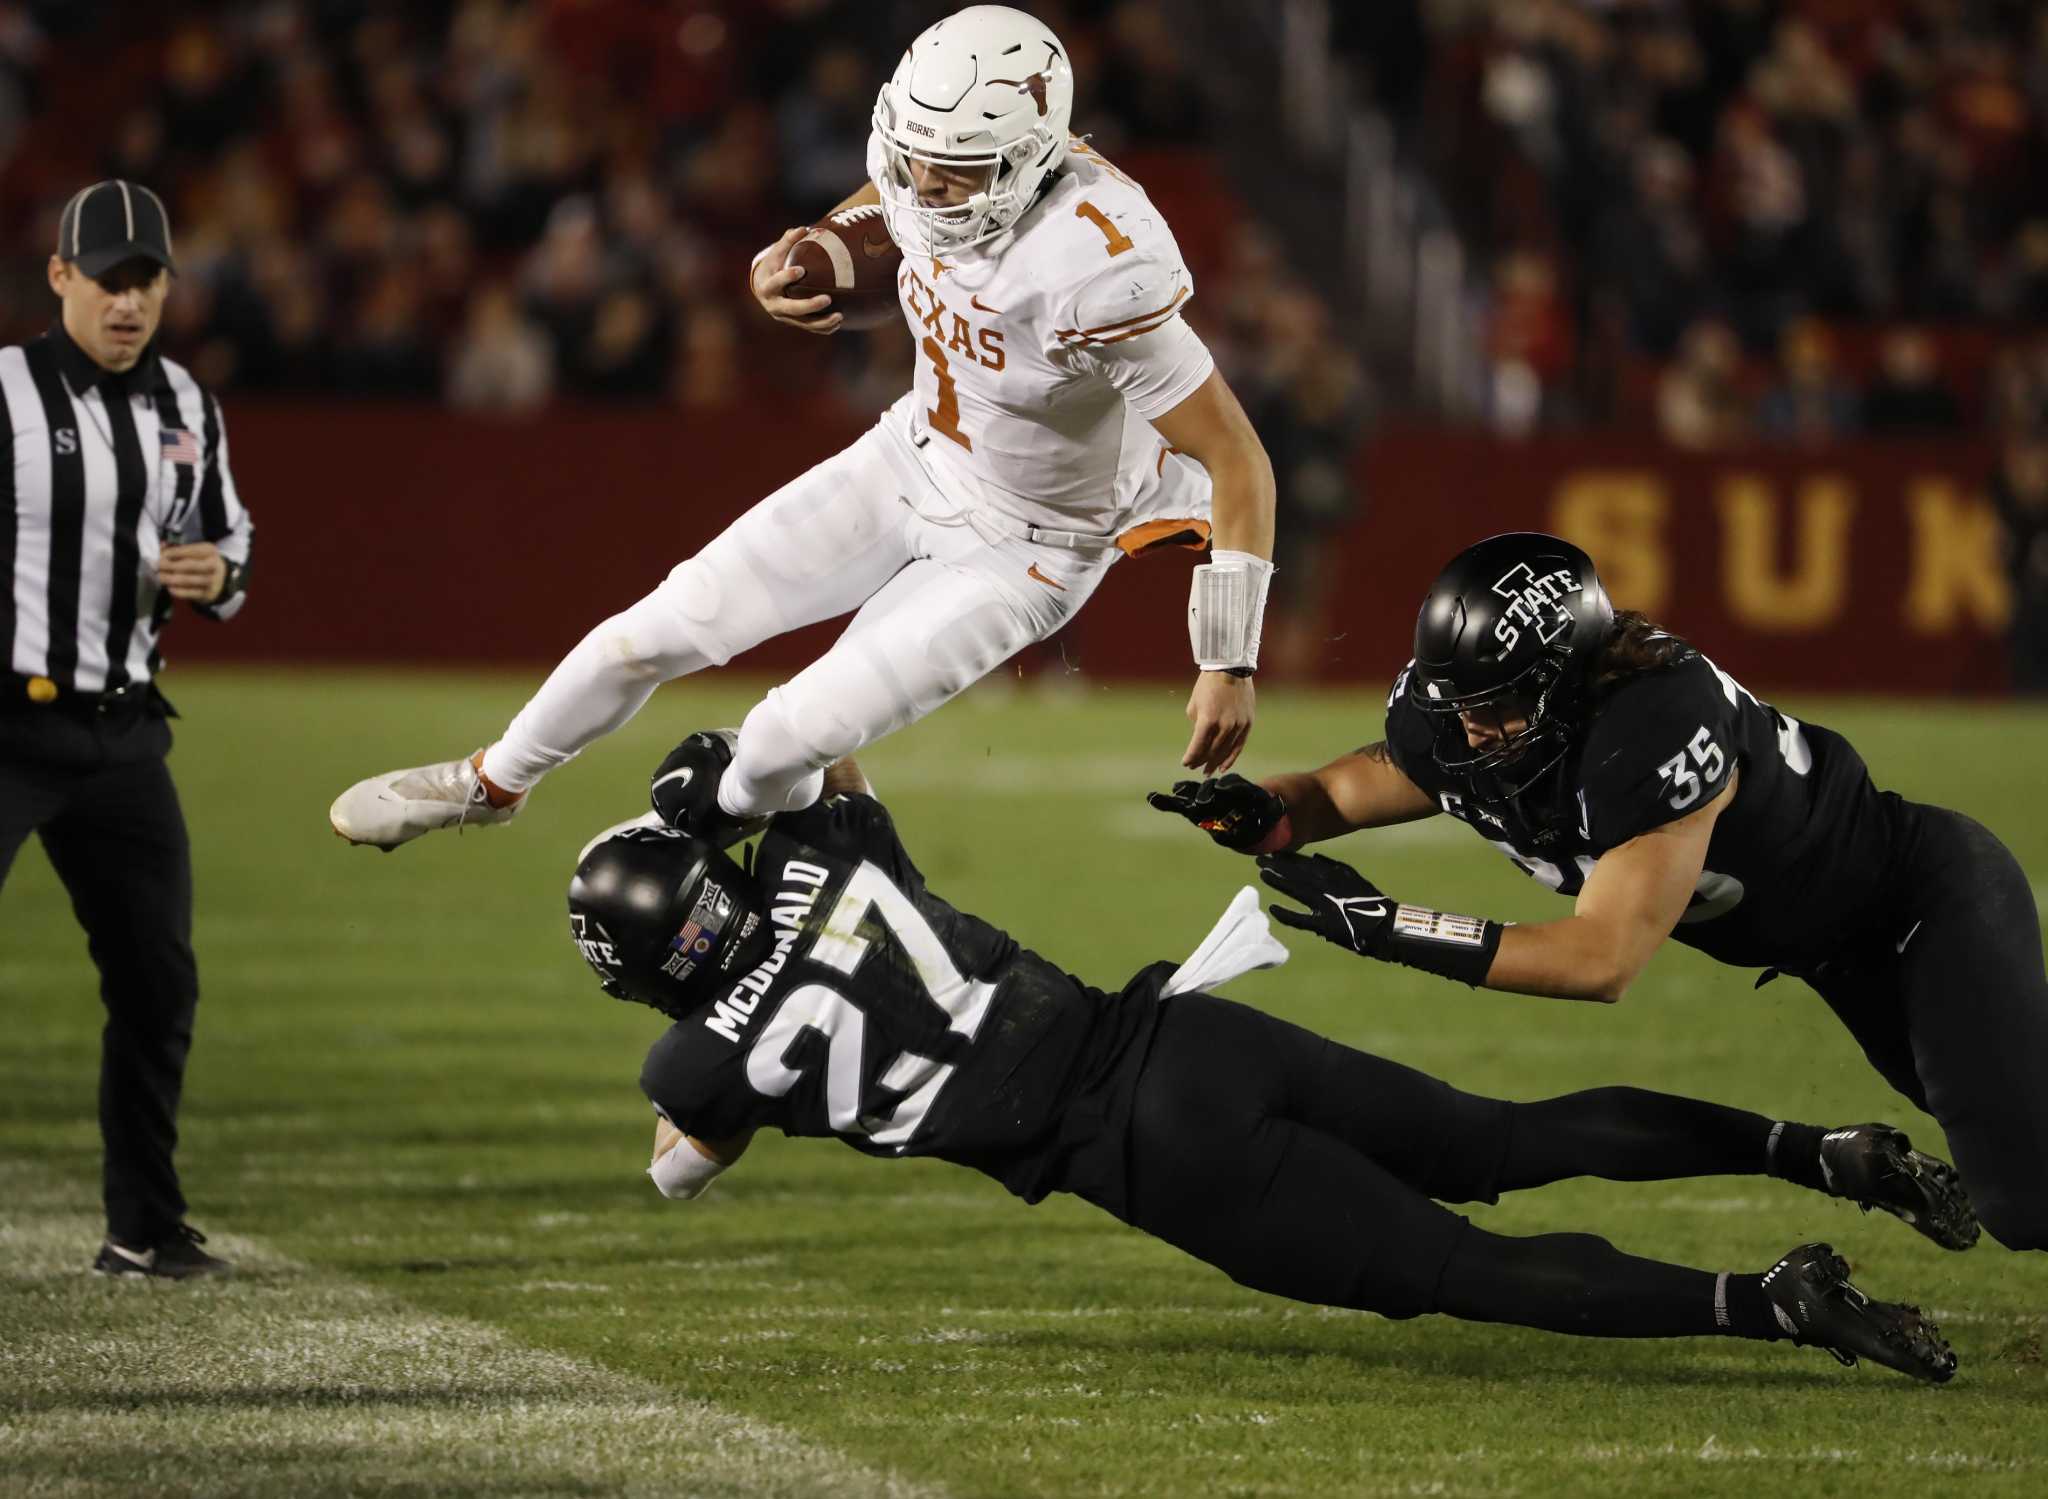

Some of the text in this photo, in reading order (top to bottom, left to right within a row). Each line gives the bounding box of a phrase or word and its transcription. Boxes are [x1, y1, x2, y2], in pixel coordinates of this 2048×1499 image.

[906, 120, 936, 138] HORNS
[1075, 201, 1135, 257] 1
[900, 267, 1006, 372] EXAS
[922, 335, 973, 454] 1
[55, 426, 77, 455] S
[1494, 569, 1583, 661] STATE
[1656, 725, 1724, 810] 35
[746, 858, 998, 1152] 27
